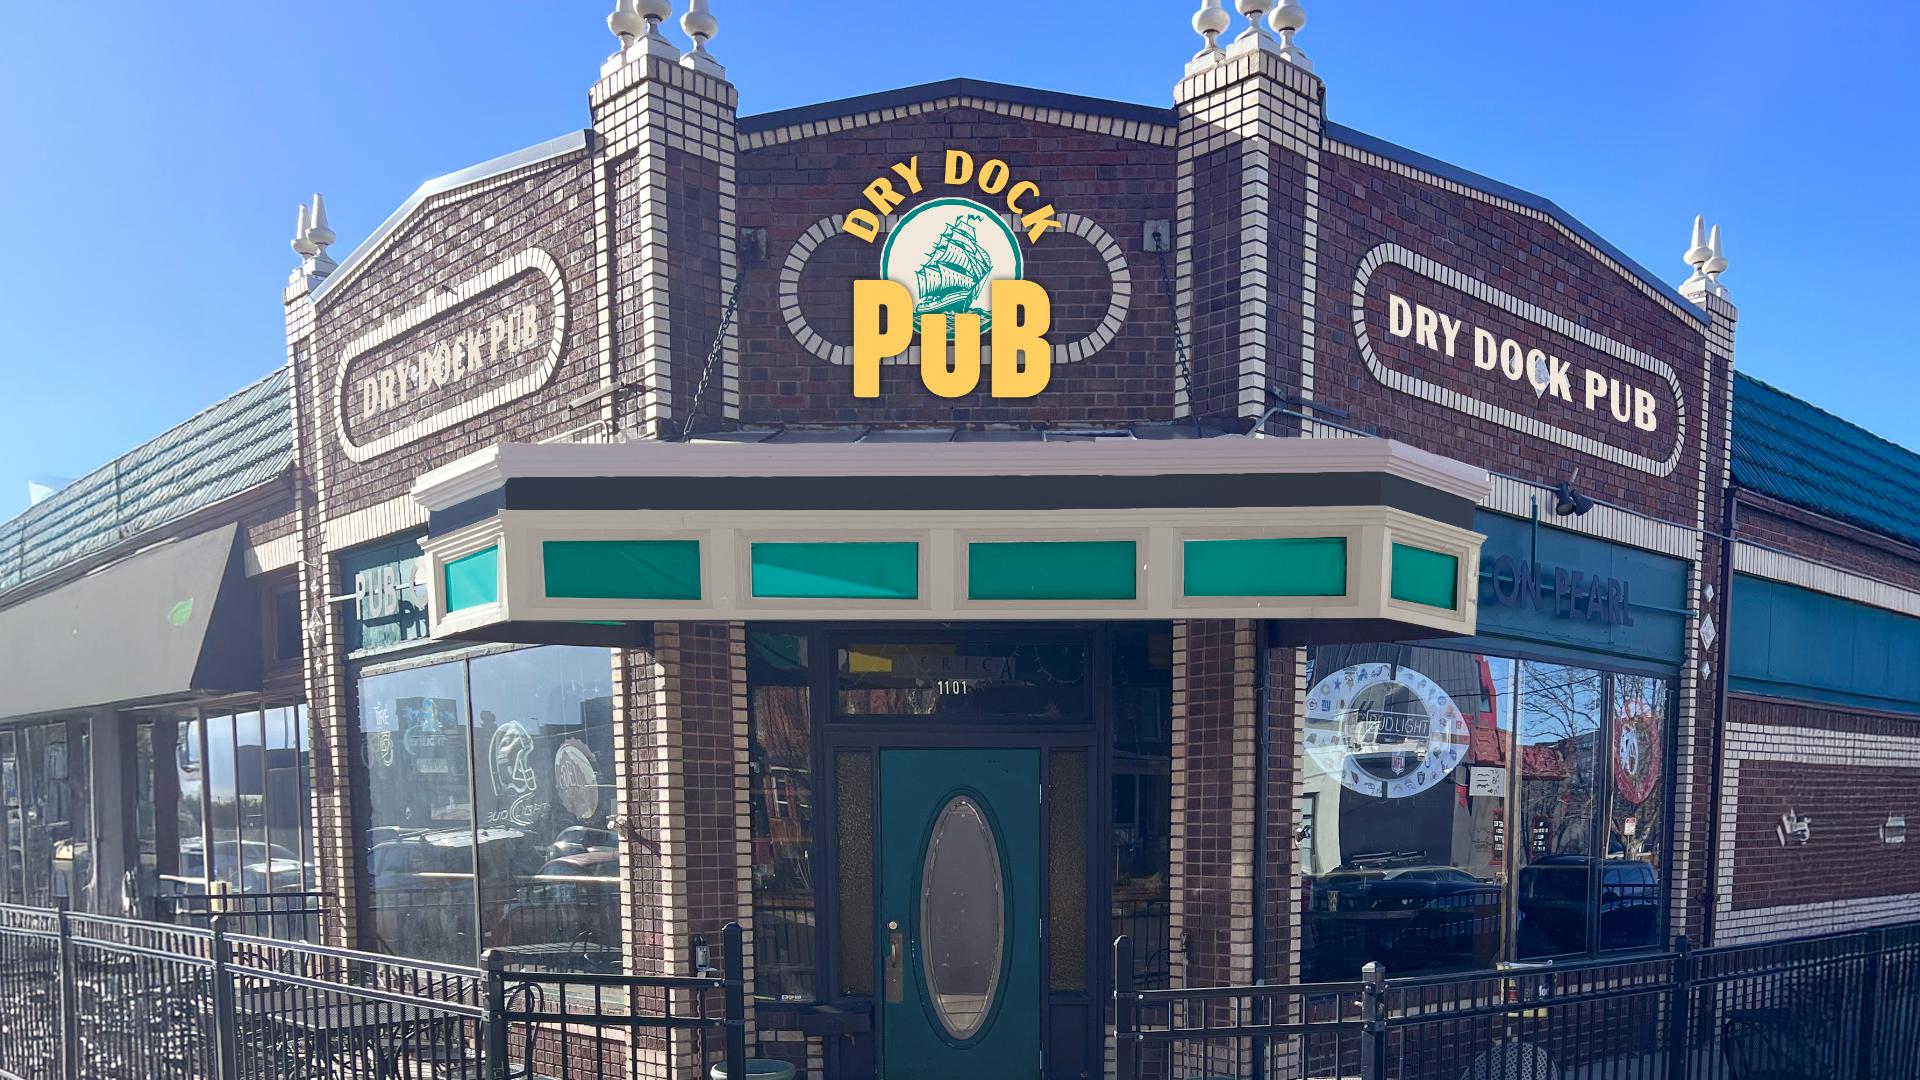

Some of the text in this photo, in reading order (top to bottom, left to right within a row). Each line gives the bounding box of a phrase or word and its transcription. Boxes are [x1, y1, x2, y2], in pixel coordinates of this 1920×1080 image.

[842, 149, 1063, 245] DRY DOCK
[362, 306, 538, 419] DRY DOCK PUB
[853, 279, 1051, 399] PUB
[1388, 293, 1657, 432] DRY DOCK PUB
[355, 566, 398, 621] PUB
[1492, 554, 1635, 628] ON PEARL
[937, 680, 967, 695] 1101
[1396, 716, 1430, 734] LIGHT
